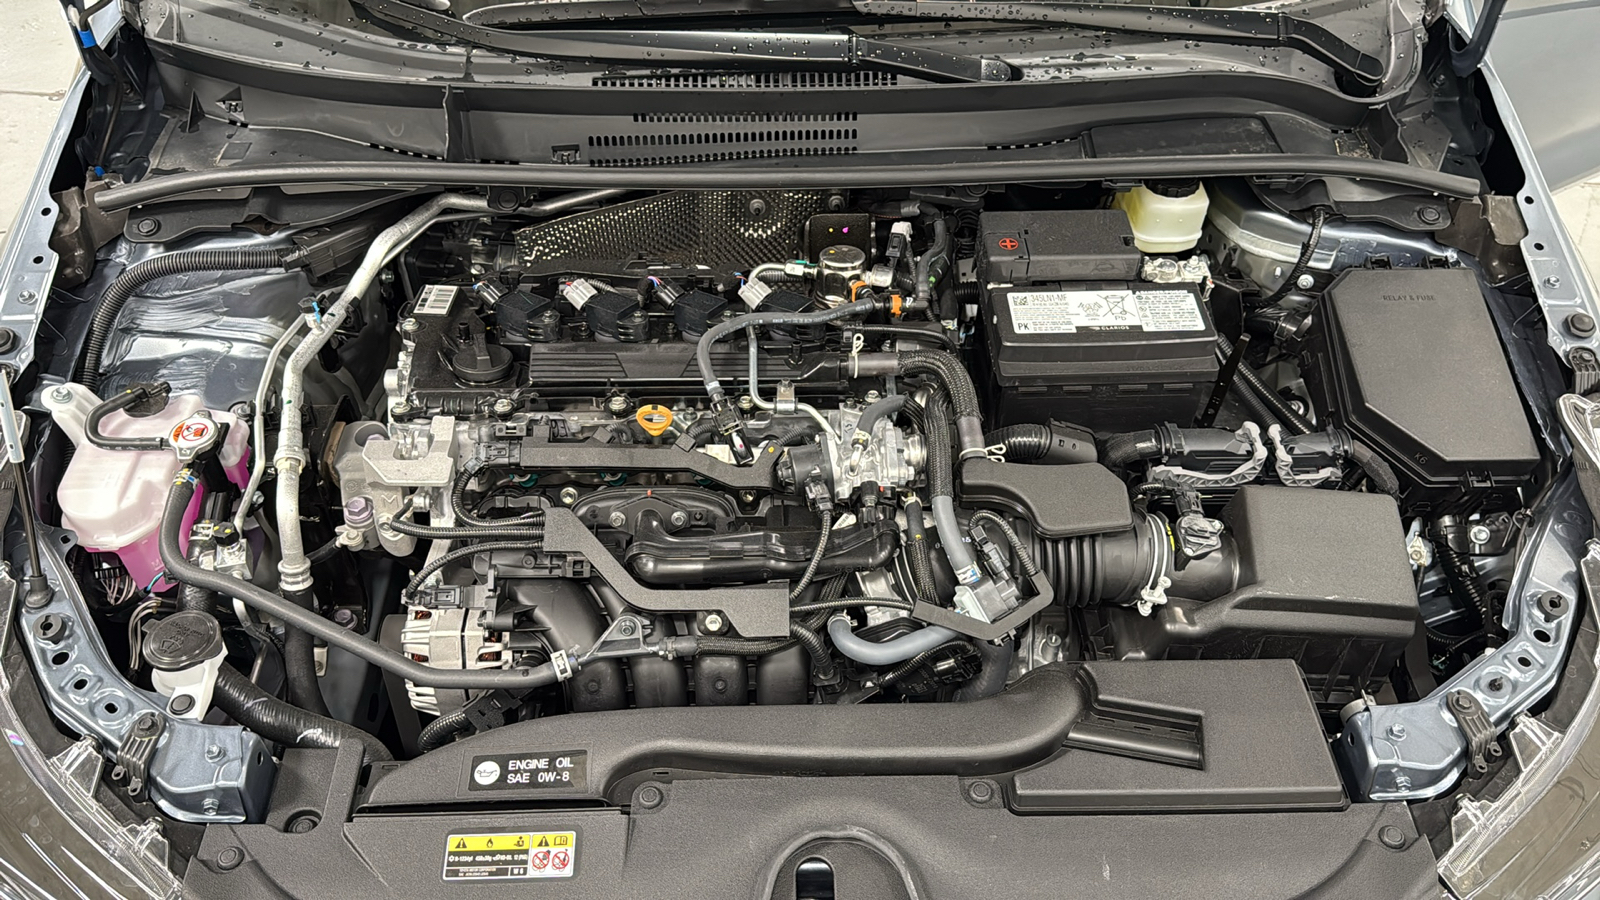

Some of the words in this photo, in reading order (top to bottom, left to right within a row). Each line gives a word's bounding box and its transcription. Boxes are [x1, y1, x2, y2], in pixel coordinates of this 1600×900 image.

[1018, 322, 1030, 331] PK
[1414, 452, 1428, 464] K6
[508, 758, 550, 771] ENGINE
[555, 757, 574, 768] OIL
[506, 773, 530, 784] SAE
[537, 771, 570, 783] 0W-8
